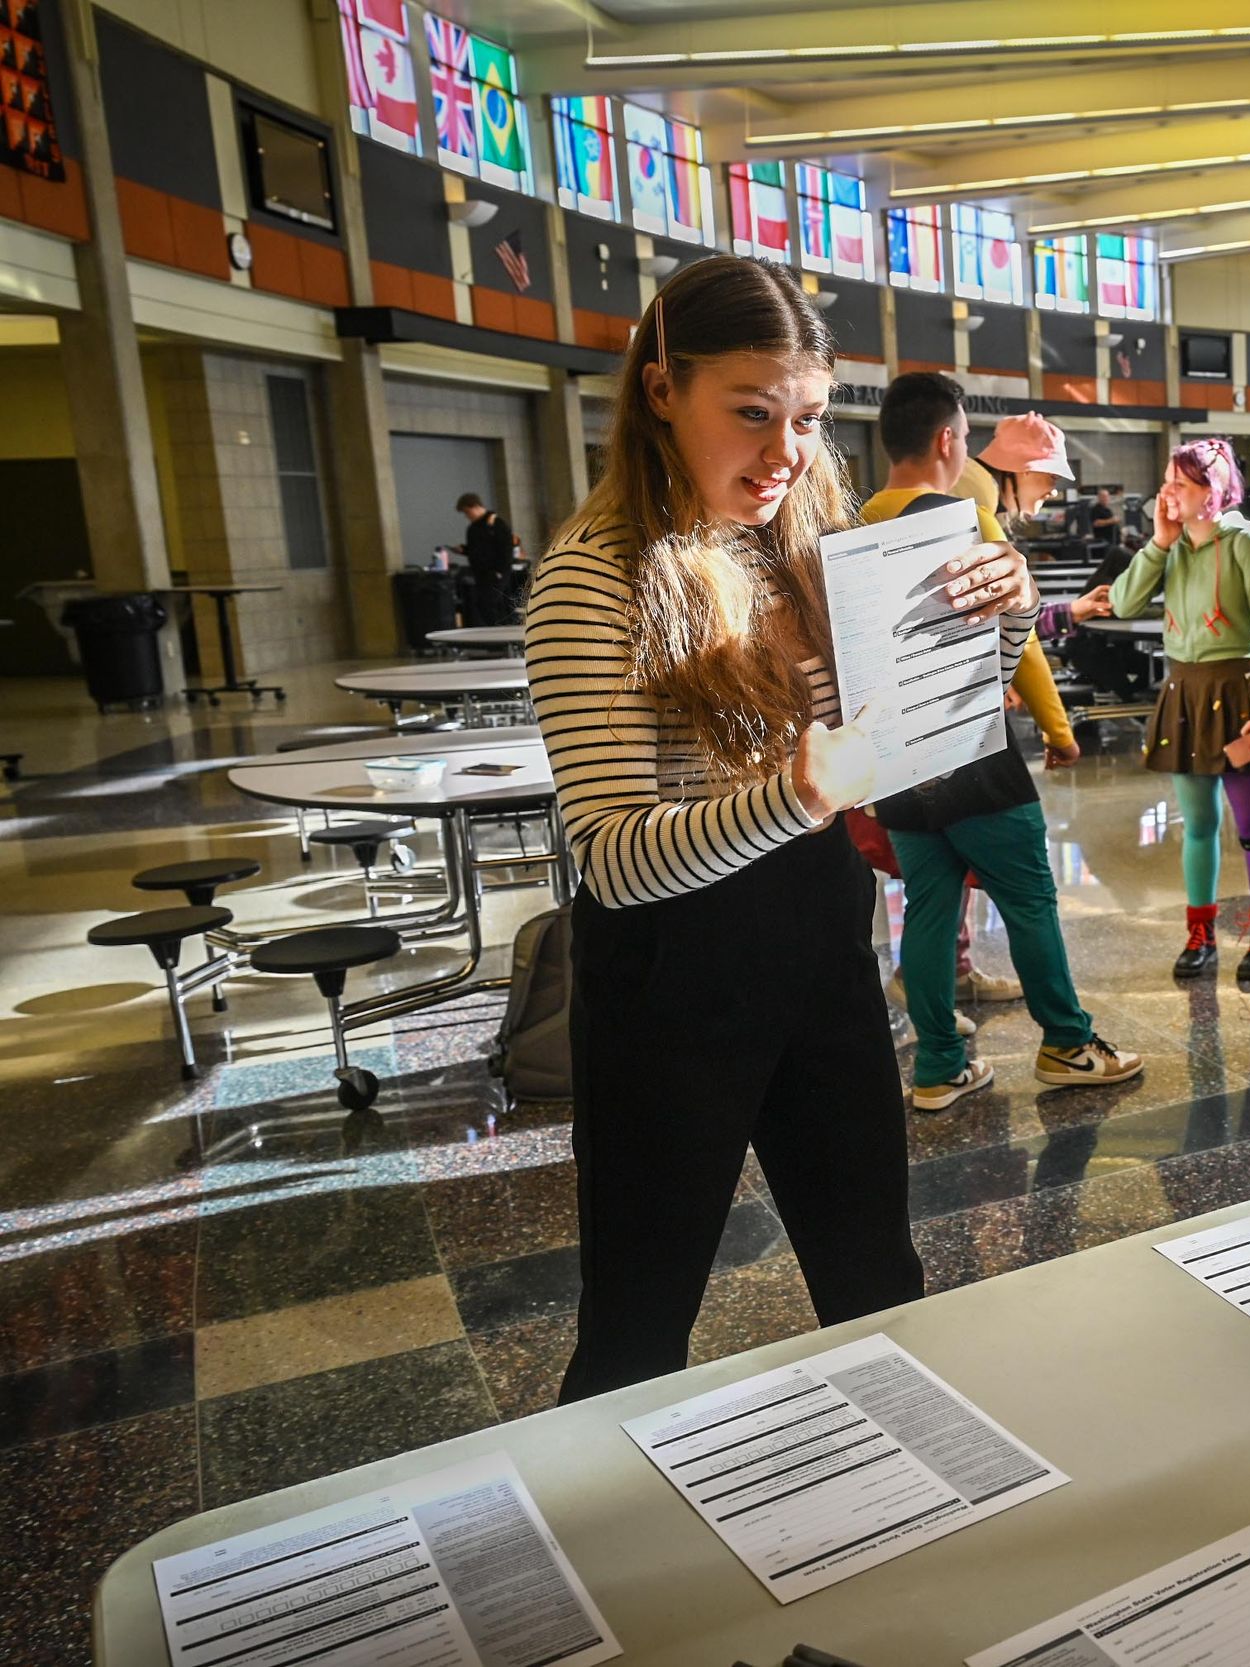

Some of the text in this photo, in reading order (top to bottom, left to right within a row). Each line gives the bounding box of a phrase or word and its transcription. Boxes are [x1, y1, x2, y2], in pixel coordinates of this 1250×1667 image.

[965, 395, 1008, 414] DING
[803, 1504, 968, 1577] Washington State Voter Registration Form
[1084, 1552, 1242, 1630] Washington State Voter Registration Form
